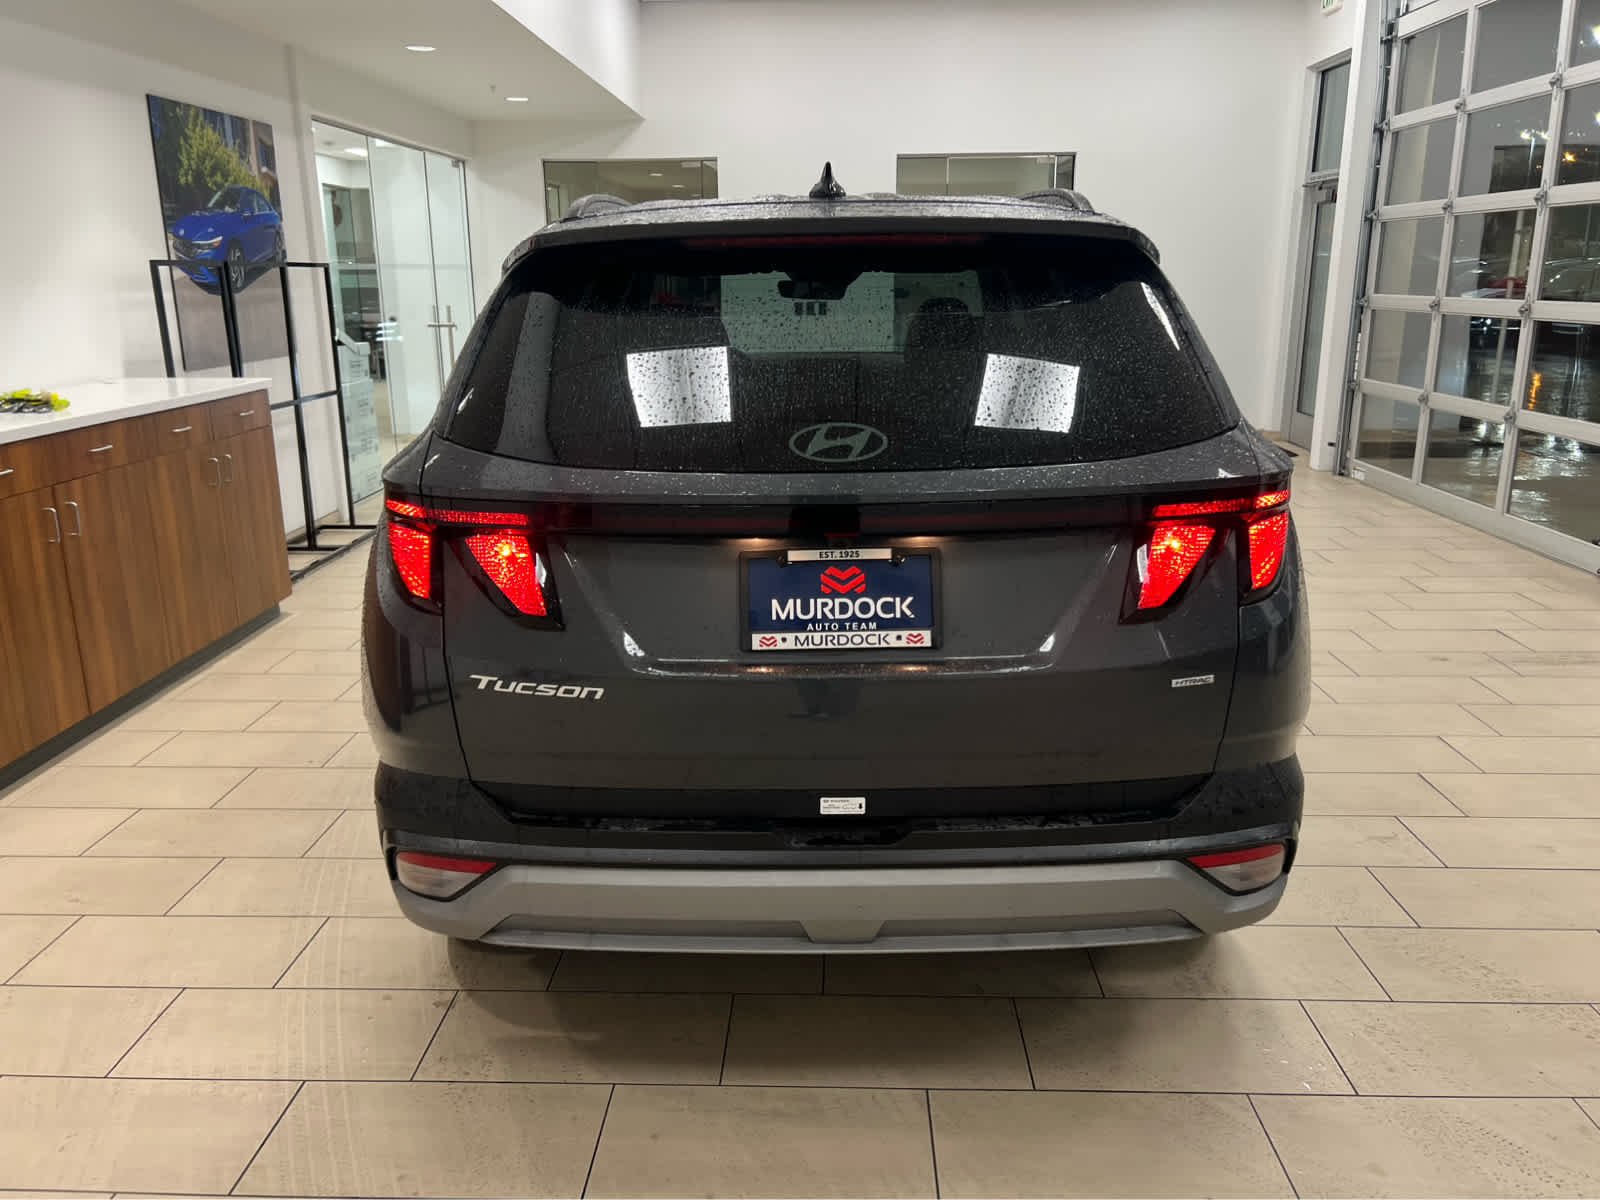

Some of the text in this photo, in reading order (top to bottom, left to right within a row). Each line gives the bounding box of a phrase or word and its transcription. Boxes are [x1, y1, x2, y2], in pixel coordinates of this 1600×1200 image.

[819, 550, 860, 559] EST. 1925
[771, 596, 915, 621] MURDOCK
[806, 622, 877, 631] AUTO TEAM
[794, 633, 891, 647] MURDOCK
